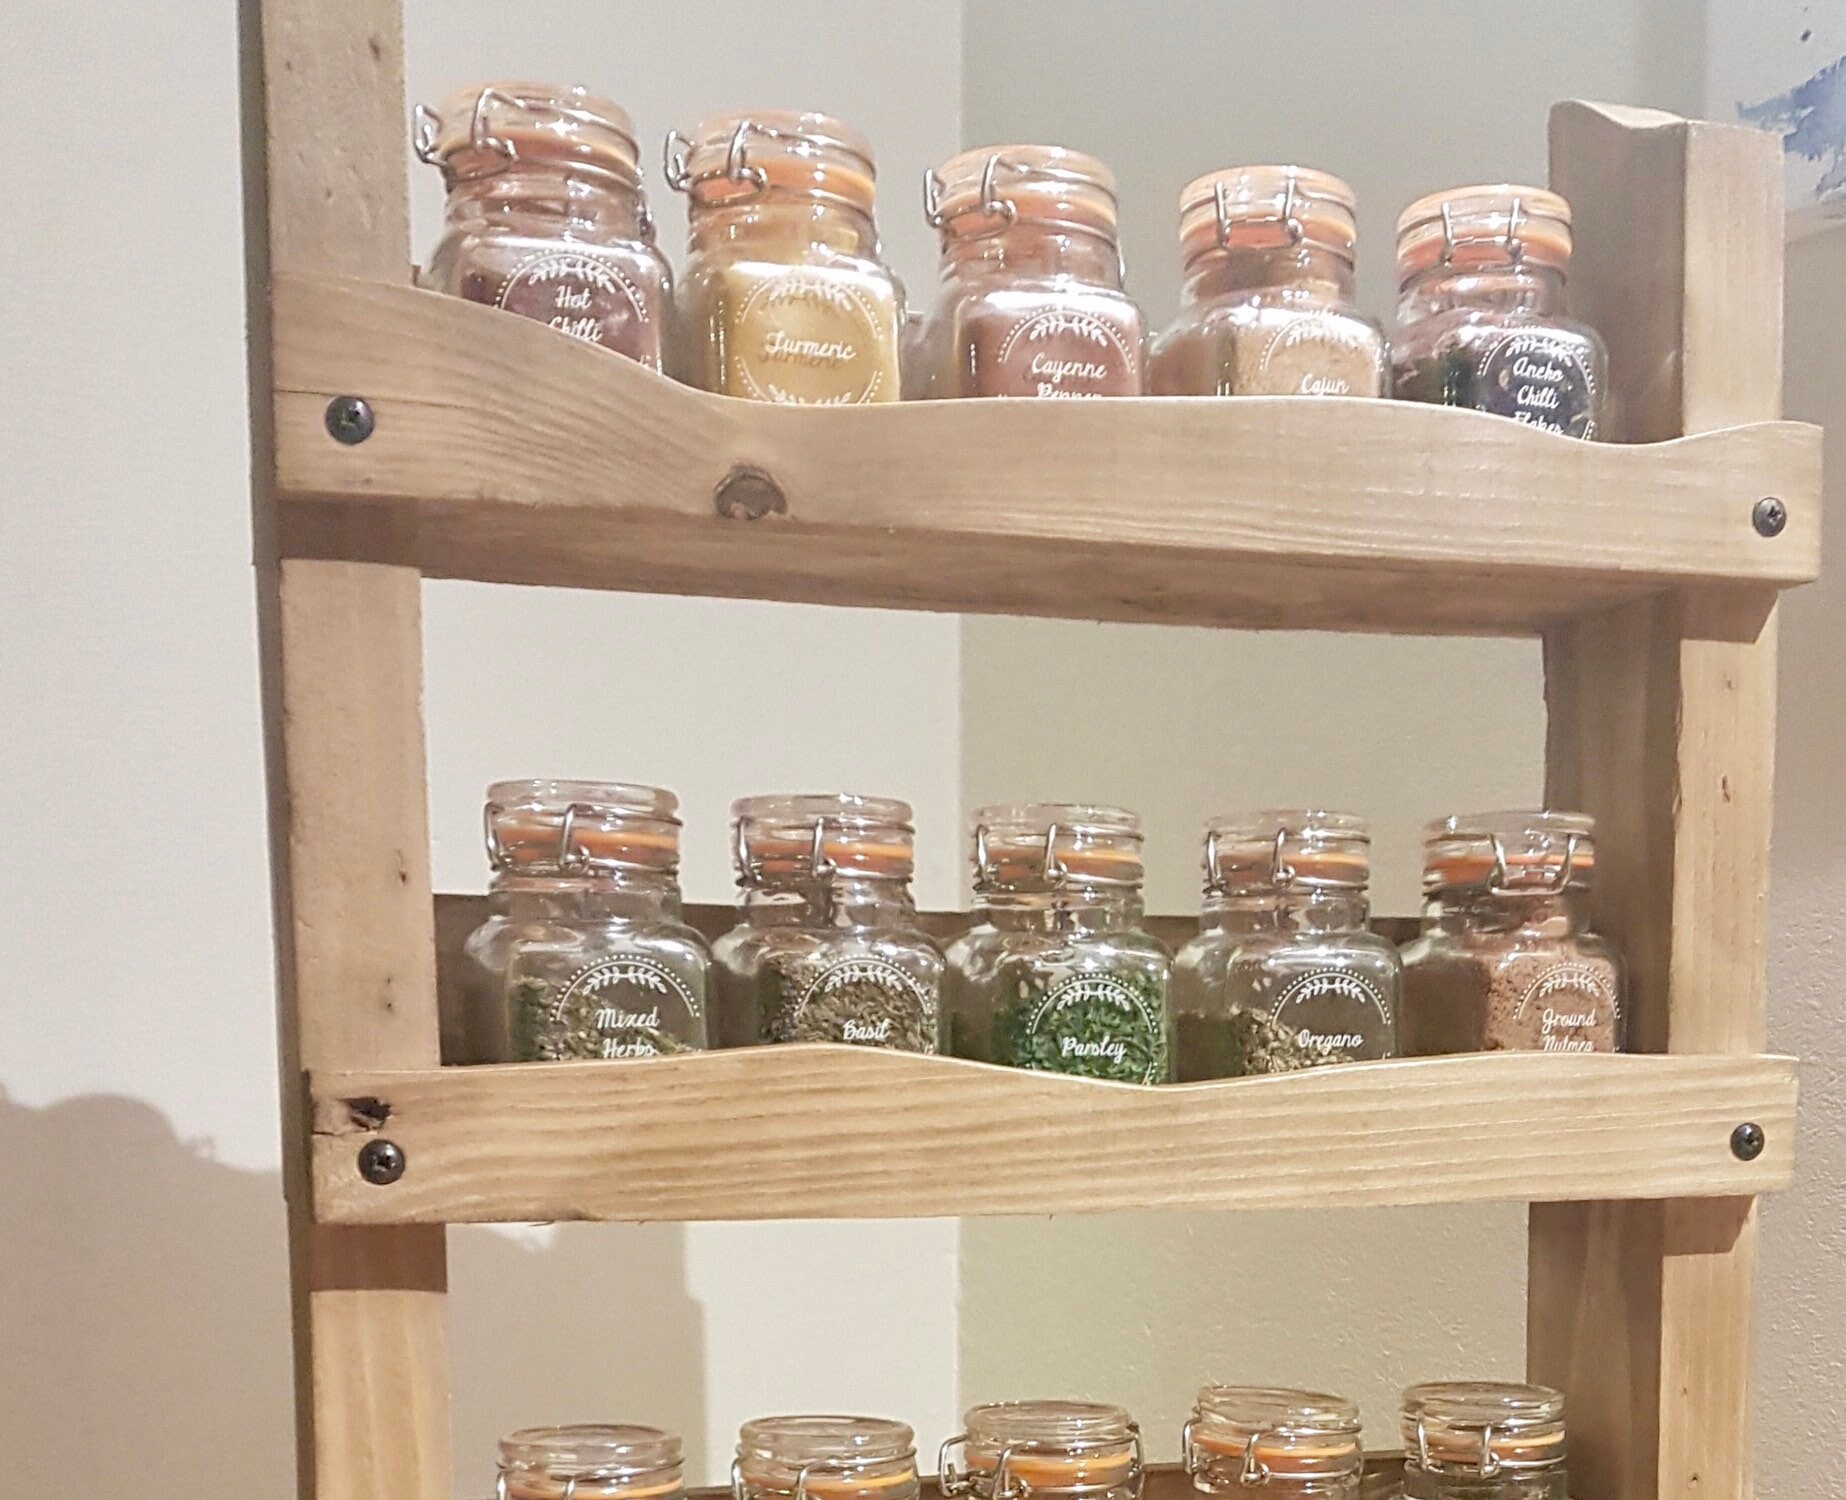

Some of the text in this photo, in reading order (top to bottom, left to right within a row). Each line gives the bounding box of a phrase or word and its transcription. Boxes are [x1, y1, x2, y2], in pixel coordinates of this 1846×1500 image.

[555, 285, 592, 309] Hot
[765, 330, 856, 359] Turmeric
[1032, 352, 1107, 383] Cayenne
[1513, 357, 1564, 382] Ancho
[1301, 373, 1350, 396] Cajun
[1517, 385, 1560, 409] Chilli
[595, 1006, 660, 1029] Mixed
[842, 1018, 890, 1041] Basil
[1541, 1008, 1597, 1034] Ground
[602, 1037, 659, 1059] Herbs
[1061, 1035, 1127, 1063] Parsley
[1297, 1028, 1364, 1056] Oregano
